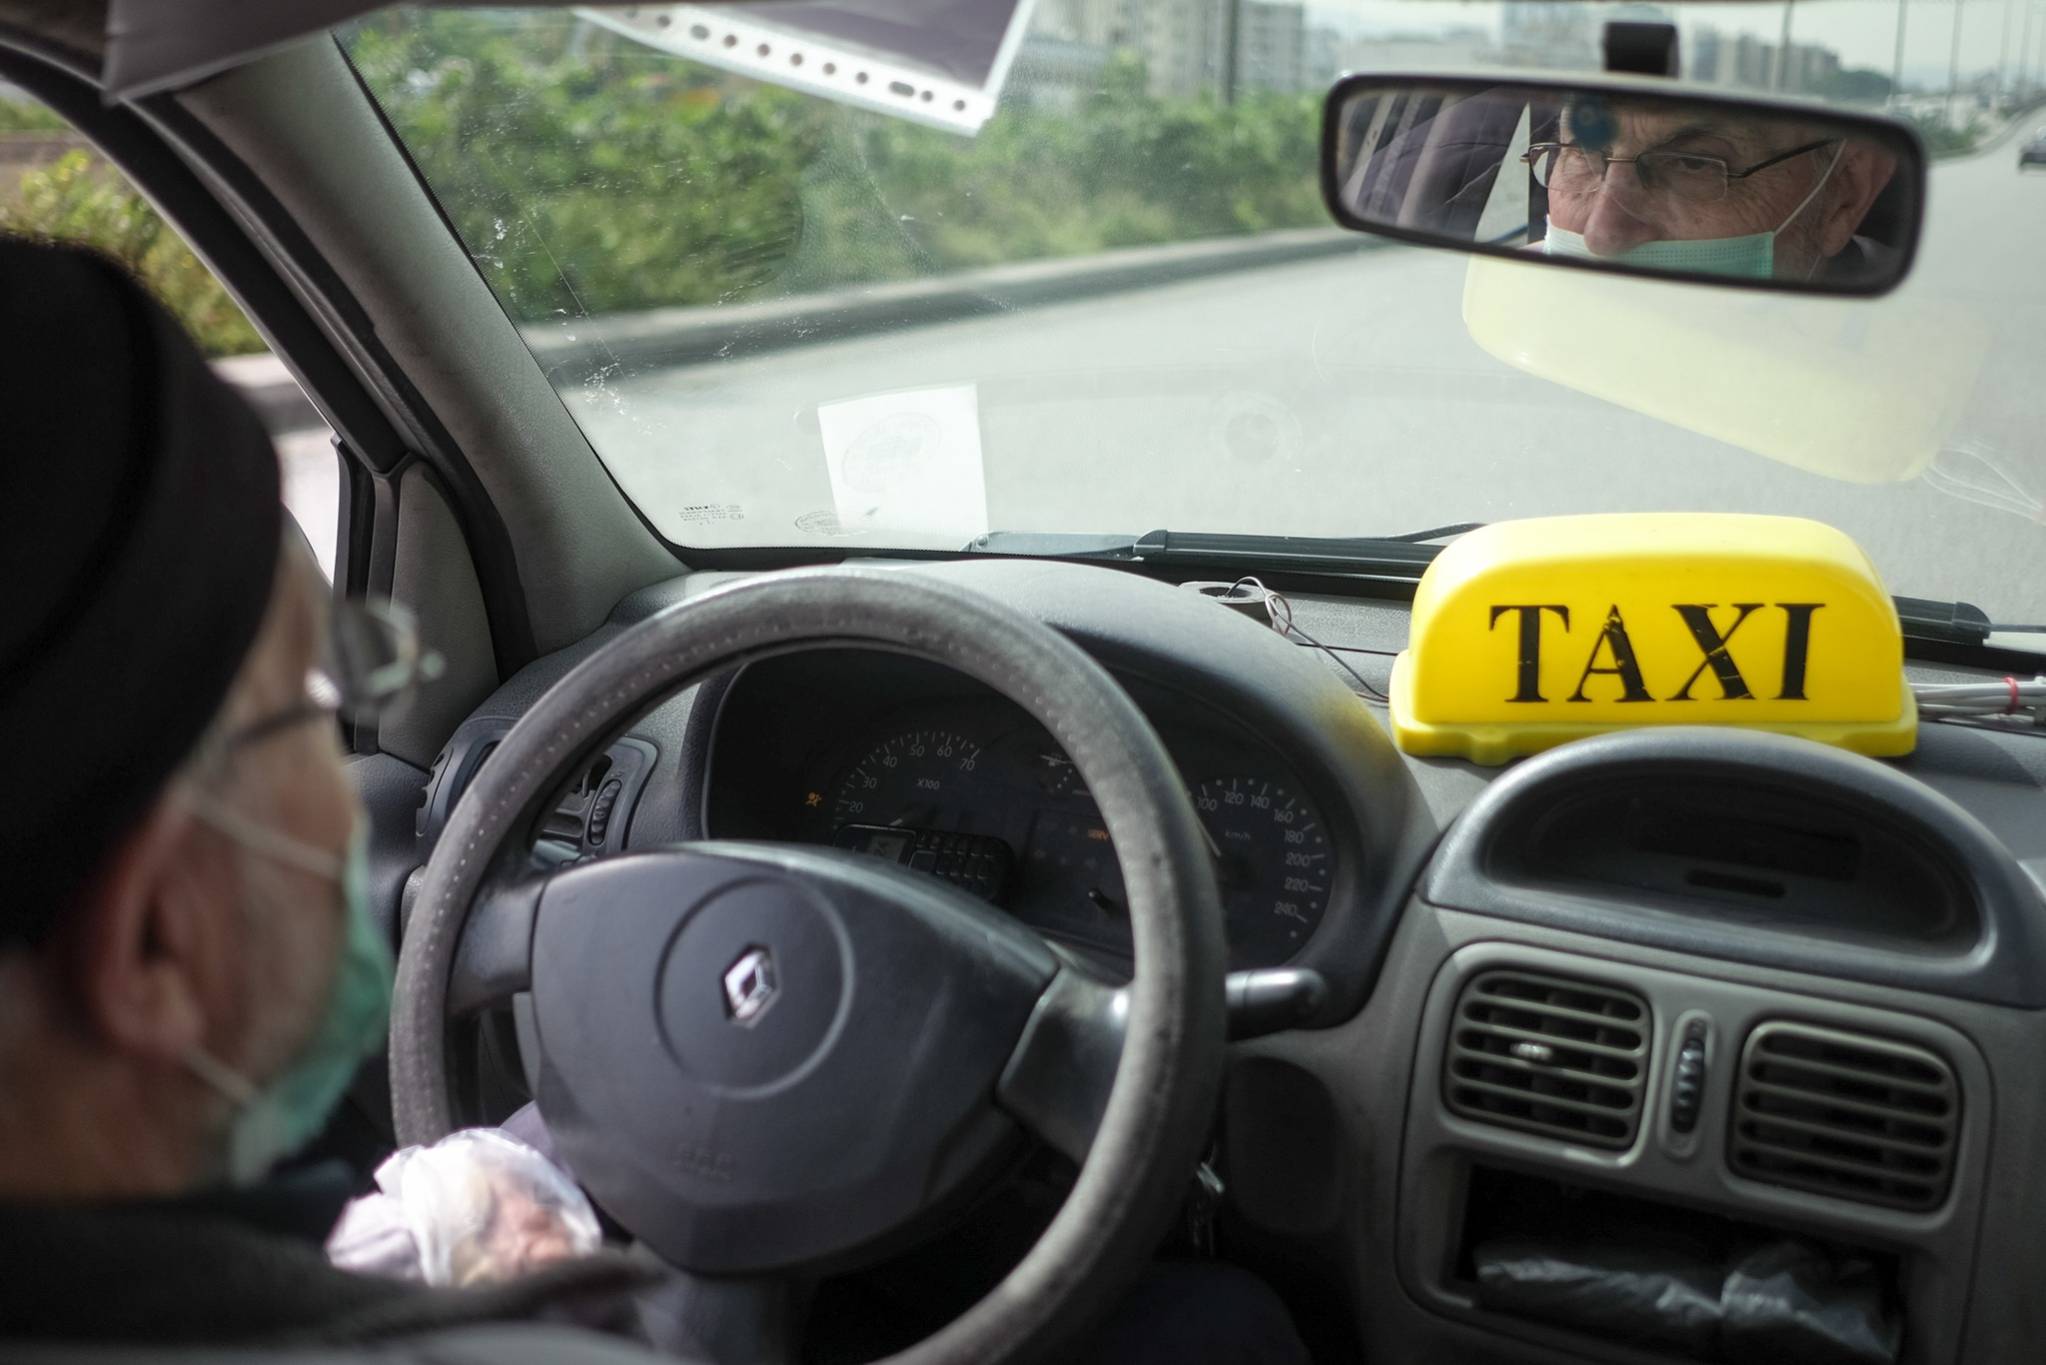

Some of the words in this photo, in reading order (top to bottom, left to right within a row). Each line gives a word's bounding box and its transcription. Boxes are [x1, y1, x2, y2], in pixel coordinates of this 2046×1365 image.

[1489, 603, 1826, 703] TAXI
[909, 745, 925, 757] 50
[936, 745, 952, 757] 60
[882, 756, 897, 768] 40
[959, 758, 975, 771] 70
[862, 778, 878, 789] 30
[1197, 797, 1217, 811] 100
[1224, 791, 1244, 805] 120
[1250, 795, 1270, 809] 140
[849, 801, 863, 813] 20
[1274, 809, 1294, 823] 160
[1225, 829, 1251, 841] km/h
[1284, 830, 1304, 844] 180
[1286, 854, 1310, 867] 200
[1284, 877, 1308, 892] 220
[1274, 901, 1297, 916] 240
